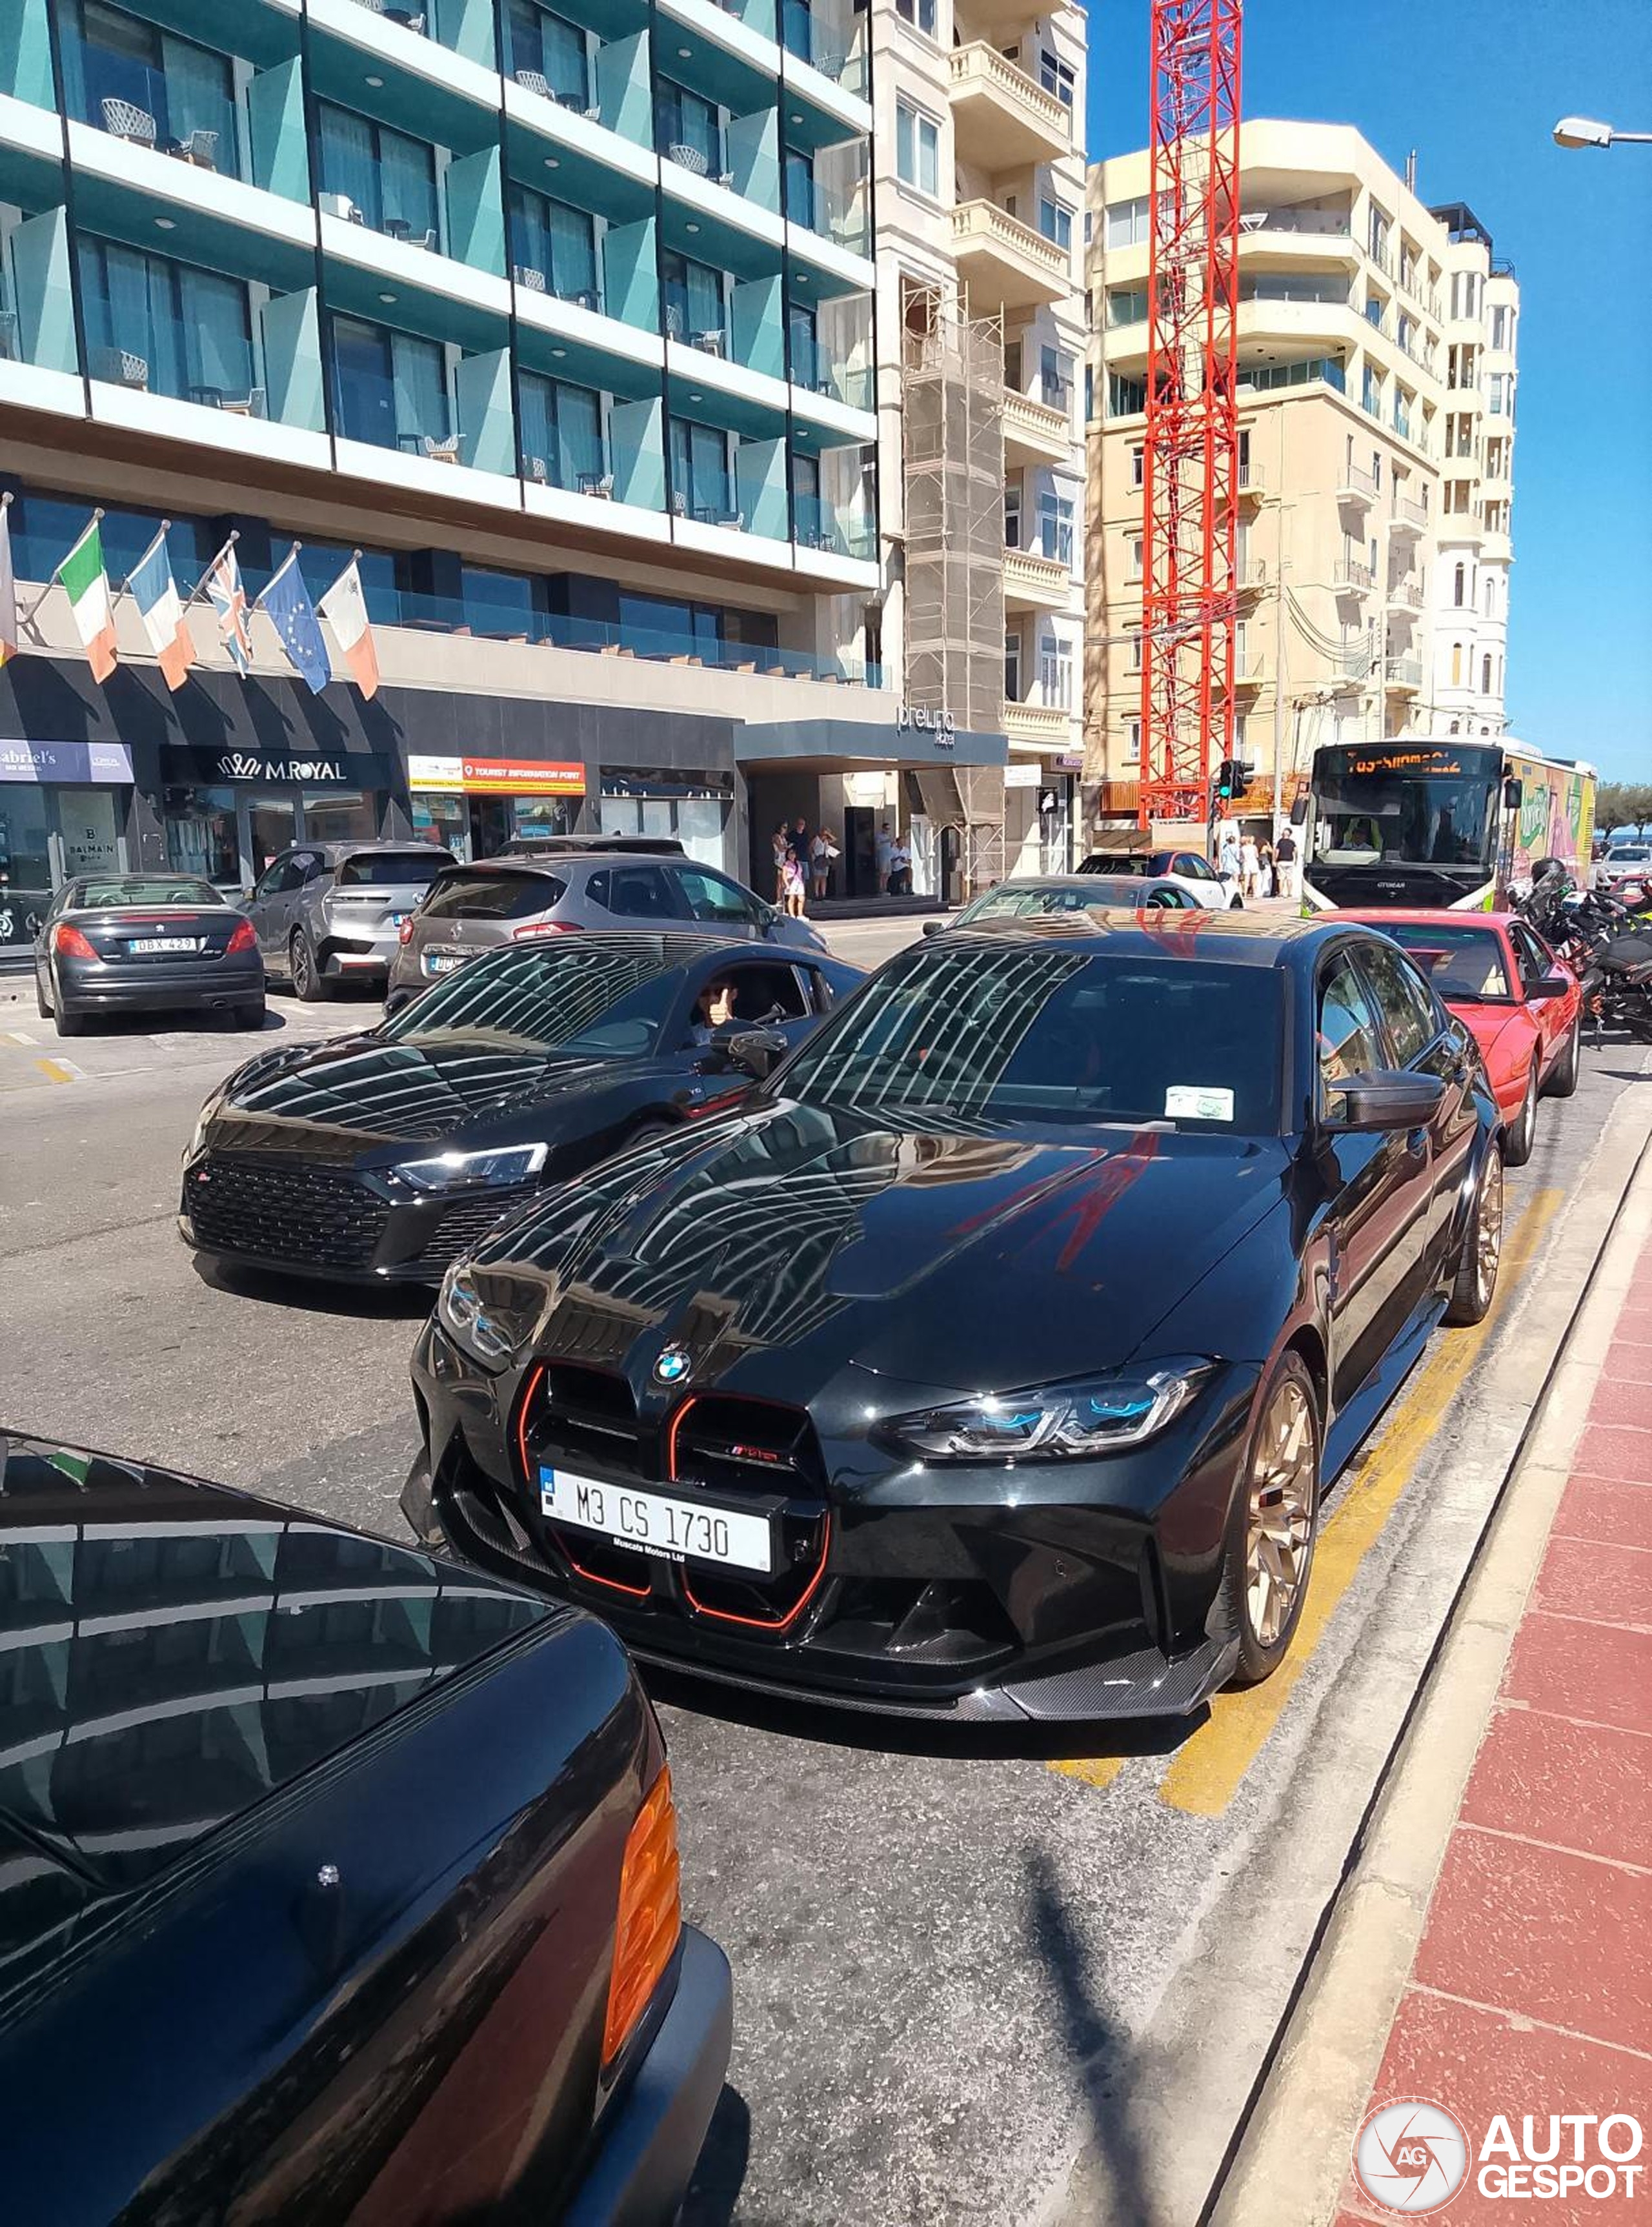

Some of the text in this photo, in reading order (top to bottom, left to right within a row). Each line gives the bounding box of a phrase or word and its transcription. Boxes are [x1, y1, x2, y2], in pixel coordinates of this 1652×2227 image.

[0, 750, 56, 765] abriel's
[474, 768, 580, 780] TOURIST INFORMATION POINT
[168, 938, 192, 950] 429
[577, 1484, 728, 1557] M3 CS 1730
[644, 1546, 671, 1560] Motors
[672, 1551, 685, 1563] Ltd
